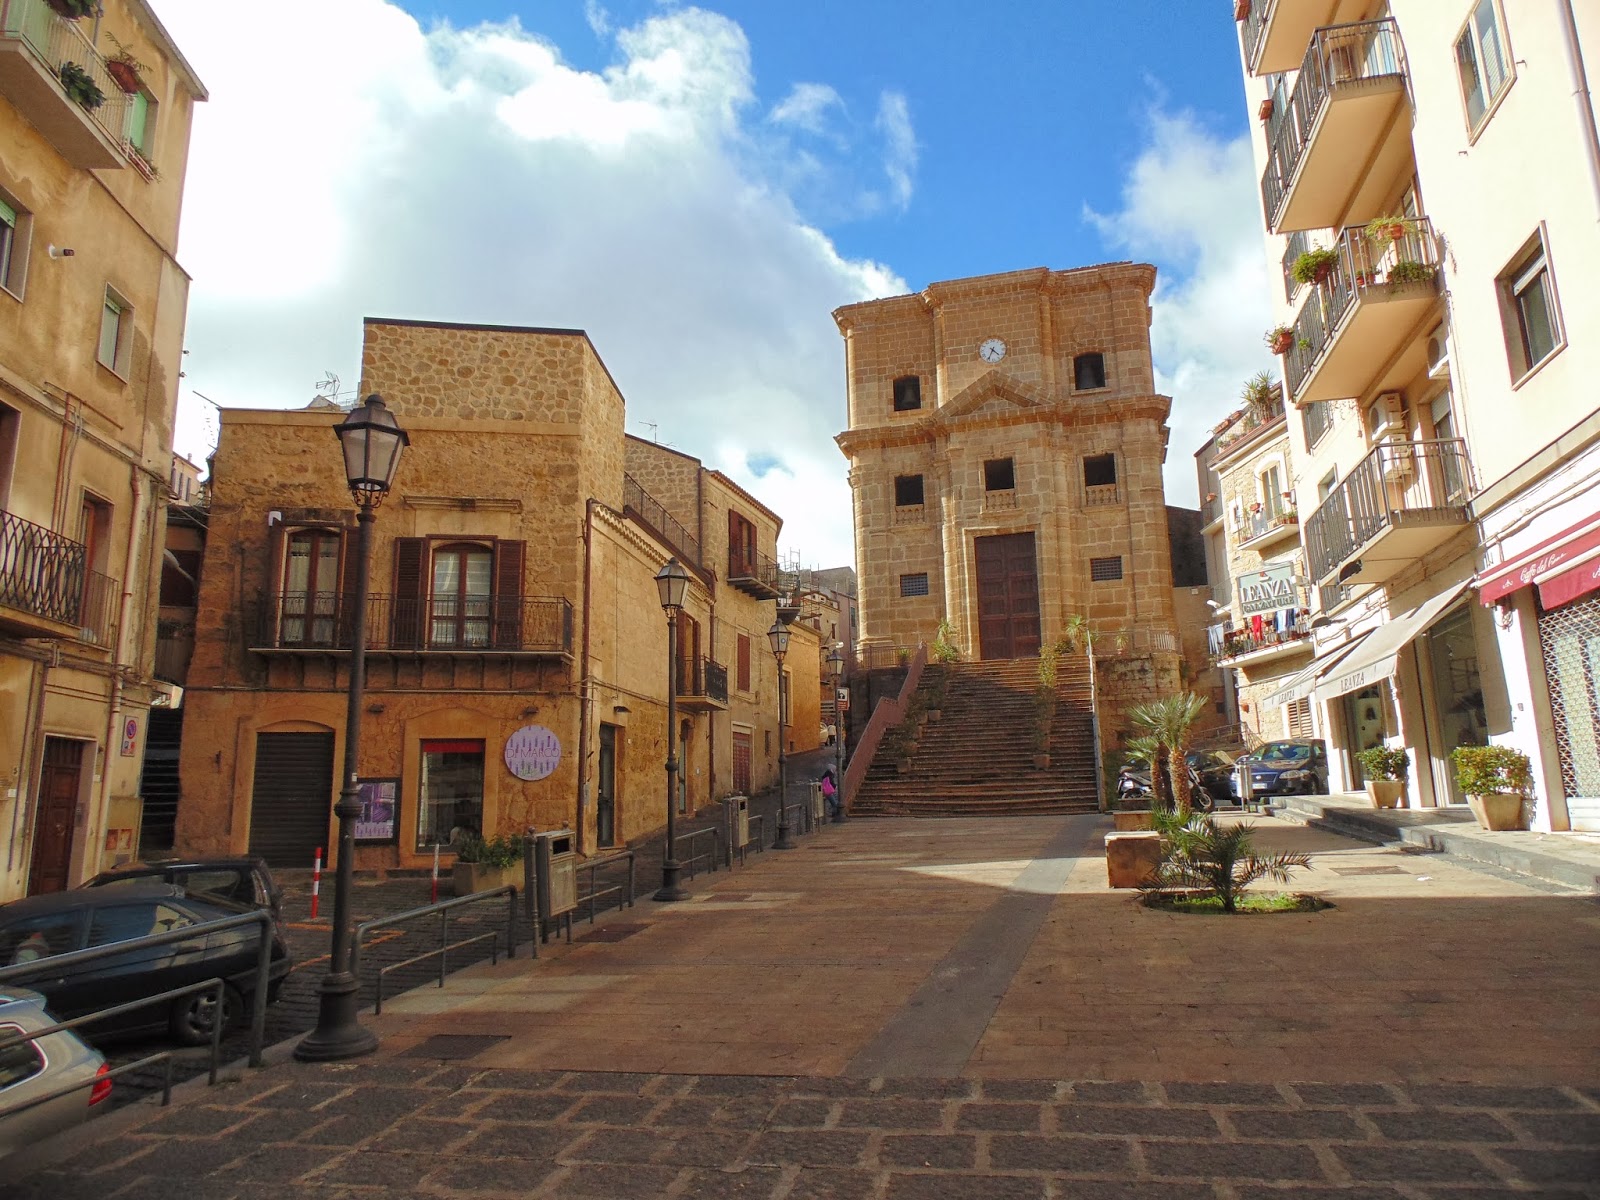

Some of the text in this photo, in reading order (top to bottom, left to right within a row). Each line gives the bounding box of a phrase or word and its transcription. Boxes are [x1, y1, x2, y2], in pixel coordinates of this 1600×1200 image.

[1239, 578, 1293, 603] LEANZA
[1242, 596, 1295, 613] CALZATURE
[1341, 671, 1365, 692] LEANZA
[520, 747, 560, 758] MARCO
